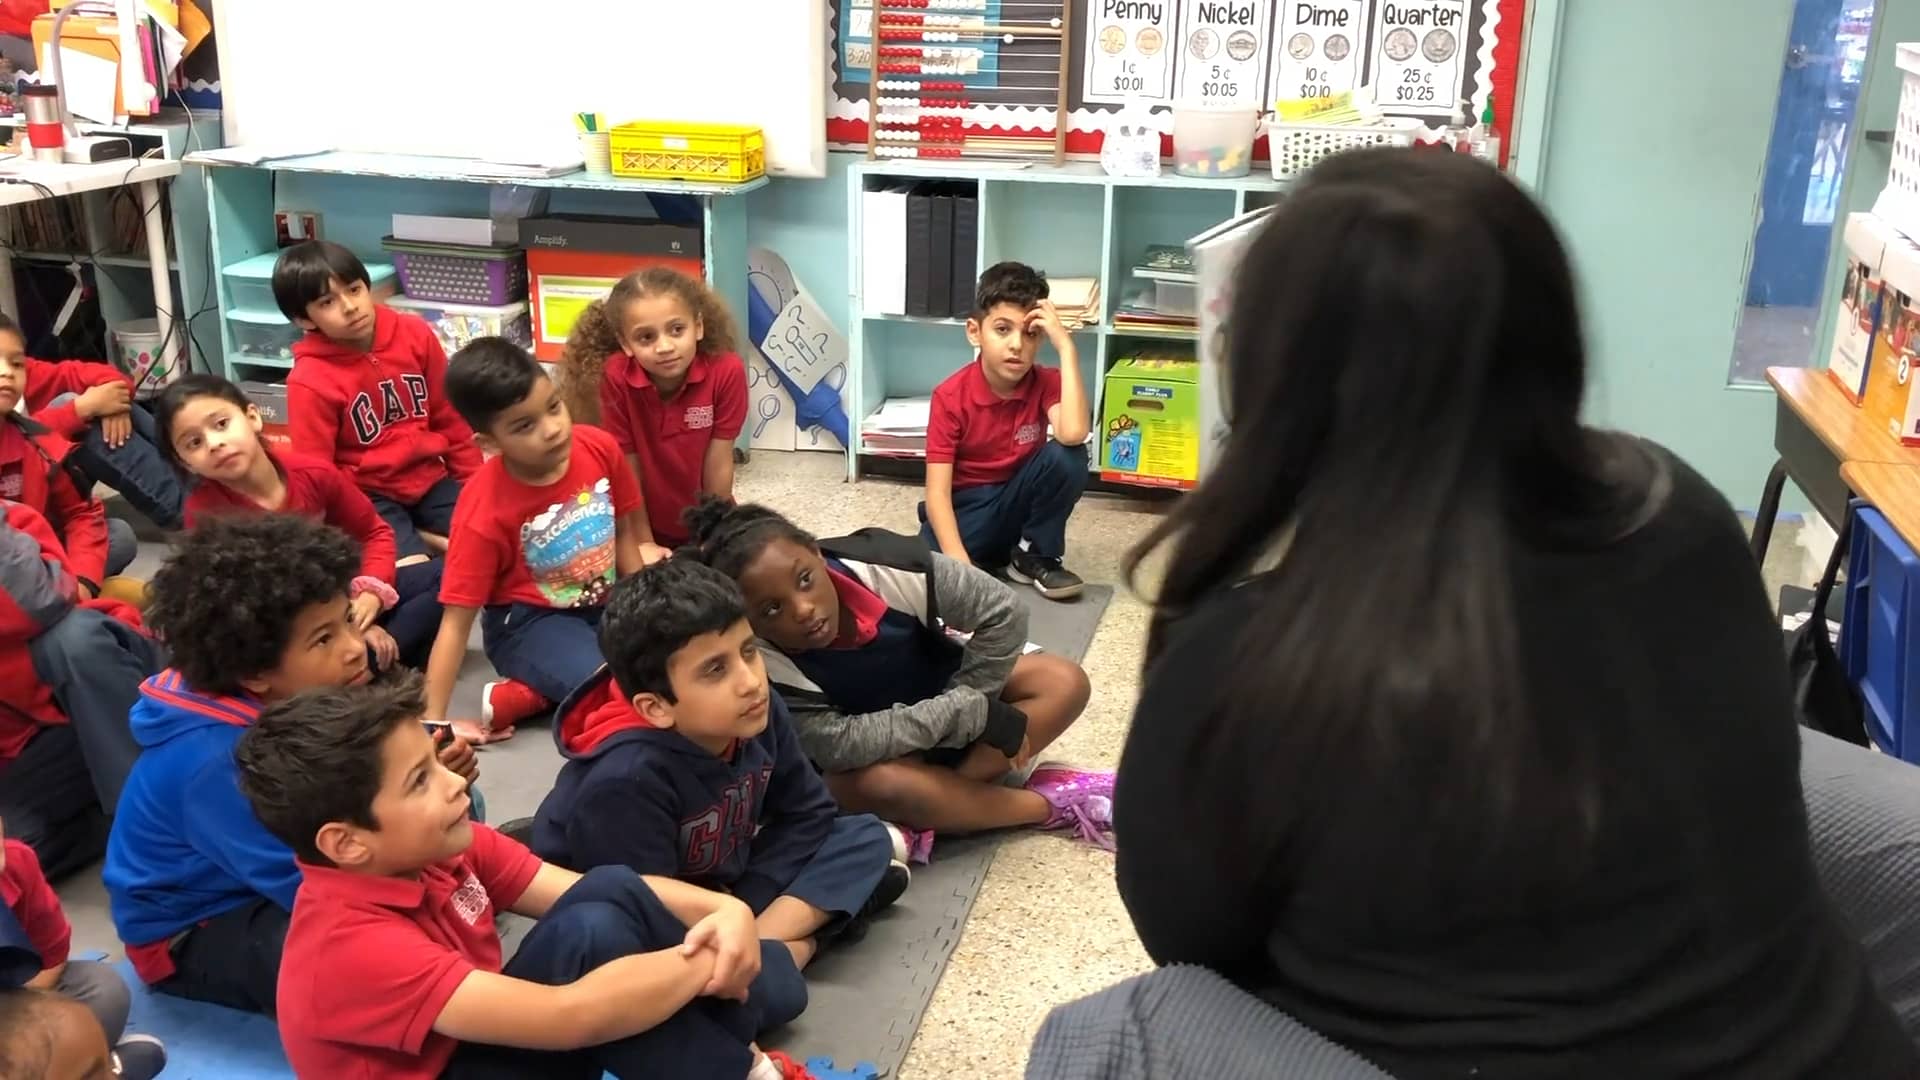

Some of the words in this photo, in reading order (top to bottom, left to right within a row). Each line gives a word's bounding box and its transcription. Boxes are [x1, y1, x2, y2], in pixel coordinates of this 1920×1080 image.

[1103, 0, 1163, 25] Penny
[1198, 1, 1256, 25] Nickel
[1296, 3, 1349, 26] Dime
[1384, 3, 1462, 26] Quarter
[1113, 76, 1144, 91] $0.01
[1202, 82, 1238, 97] $0.05
[1300, 84, 1331, 99] $0.10
[1396, 85, 1435, 101] $0.25
[350, 374, 429, 445] GAP
[530, 501, 607, 549] Excellence
